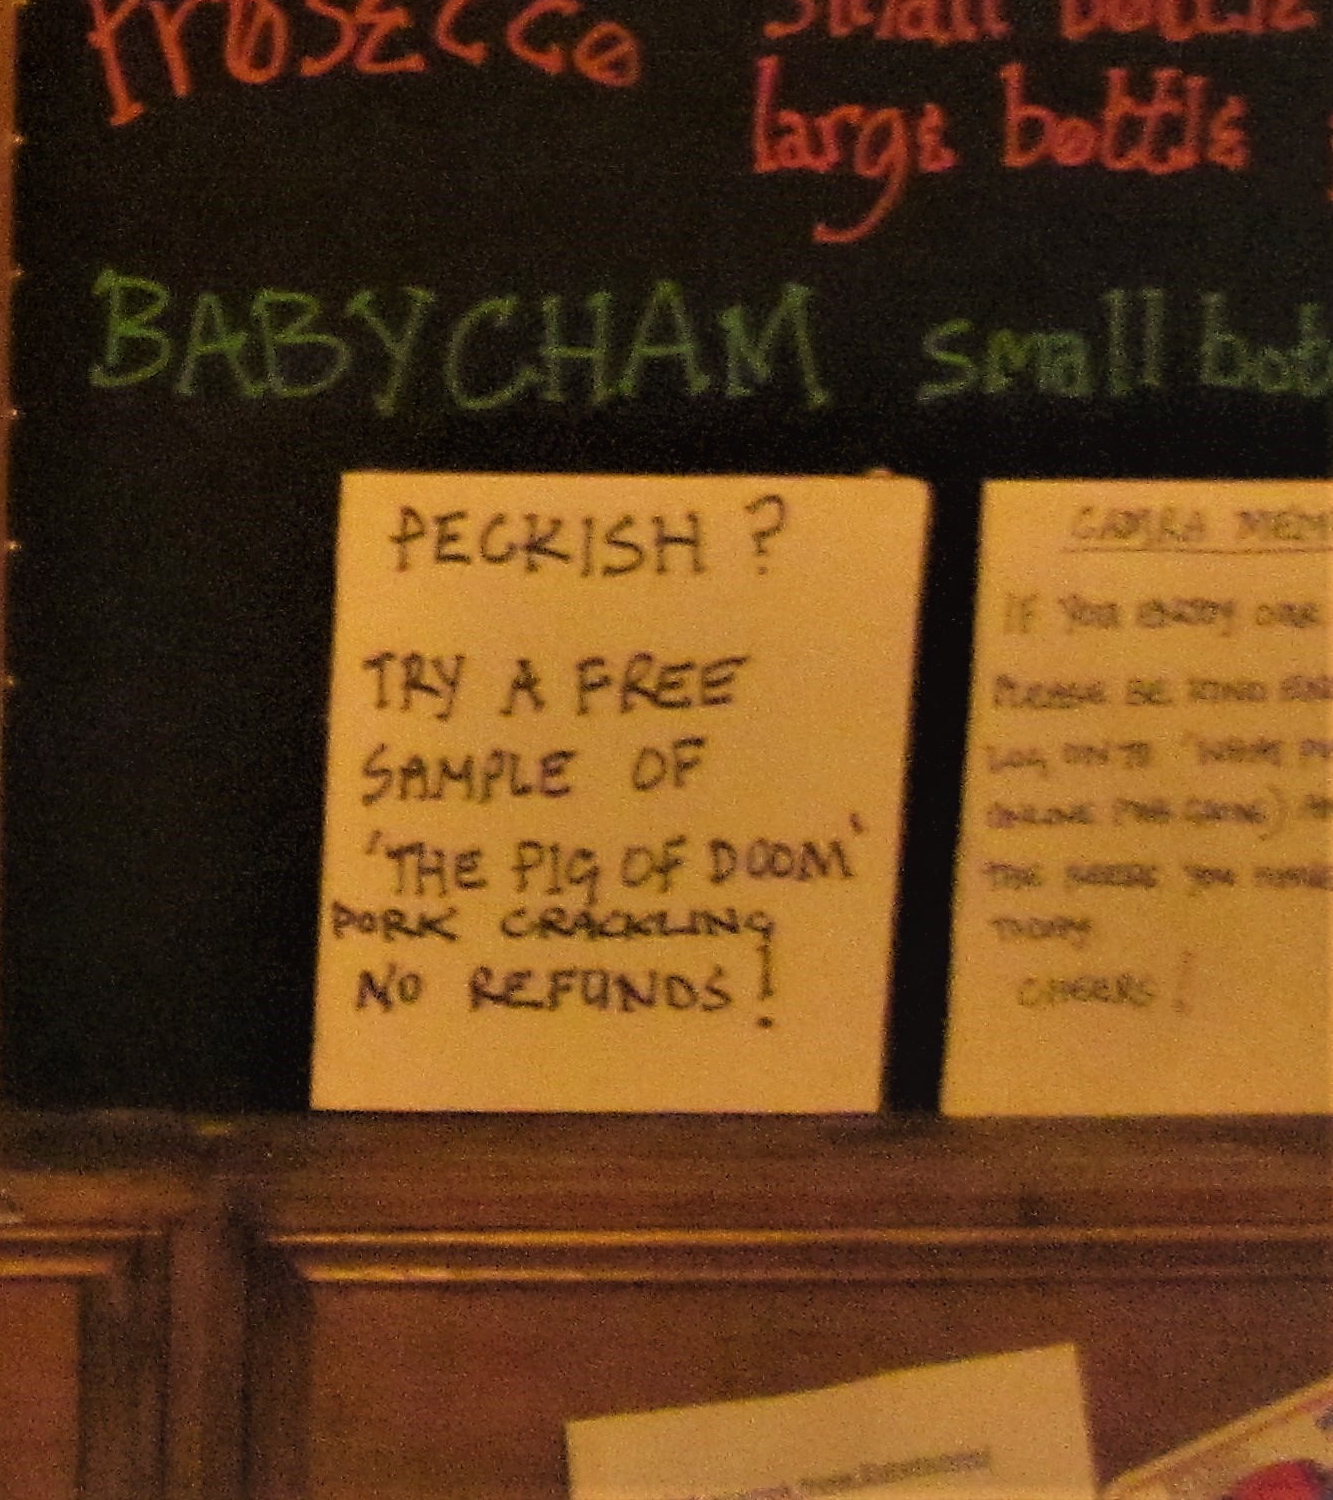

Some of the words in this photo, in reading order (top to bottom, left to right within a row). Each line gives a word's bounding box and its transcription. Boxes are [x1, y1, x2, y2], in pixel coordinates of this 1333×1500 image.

[753, 54, 960, 244] large
[999, 61, 1251, 175] bottle
[88, 267, 833, 418] BABYCHAM
[388, 505, 707, 578] PECKISH
[360, 649, 466, 722] TRY
[499, 656, 546, 716] A
[575, 651, 750, 716] FREE
[360, 742, 577, 806] SAMPLE
[631, 735, 708, 792] OF
[511, 839, 601, 906] PIG
[620, 834, 689, 893] OF
[331, 901, 460, 942] PORK
[499, 906, 777, 942] CRACKLING
[354, 962, 425, 1013] NO
